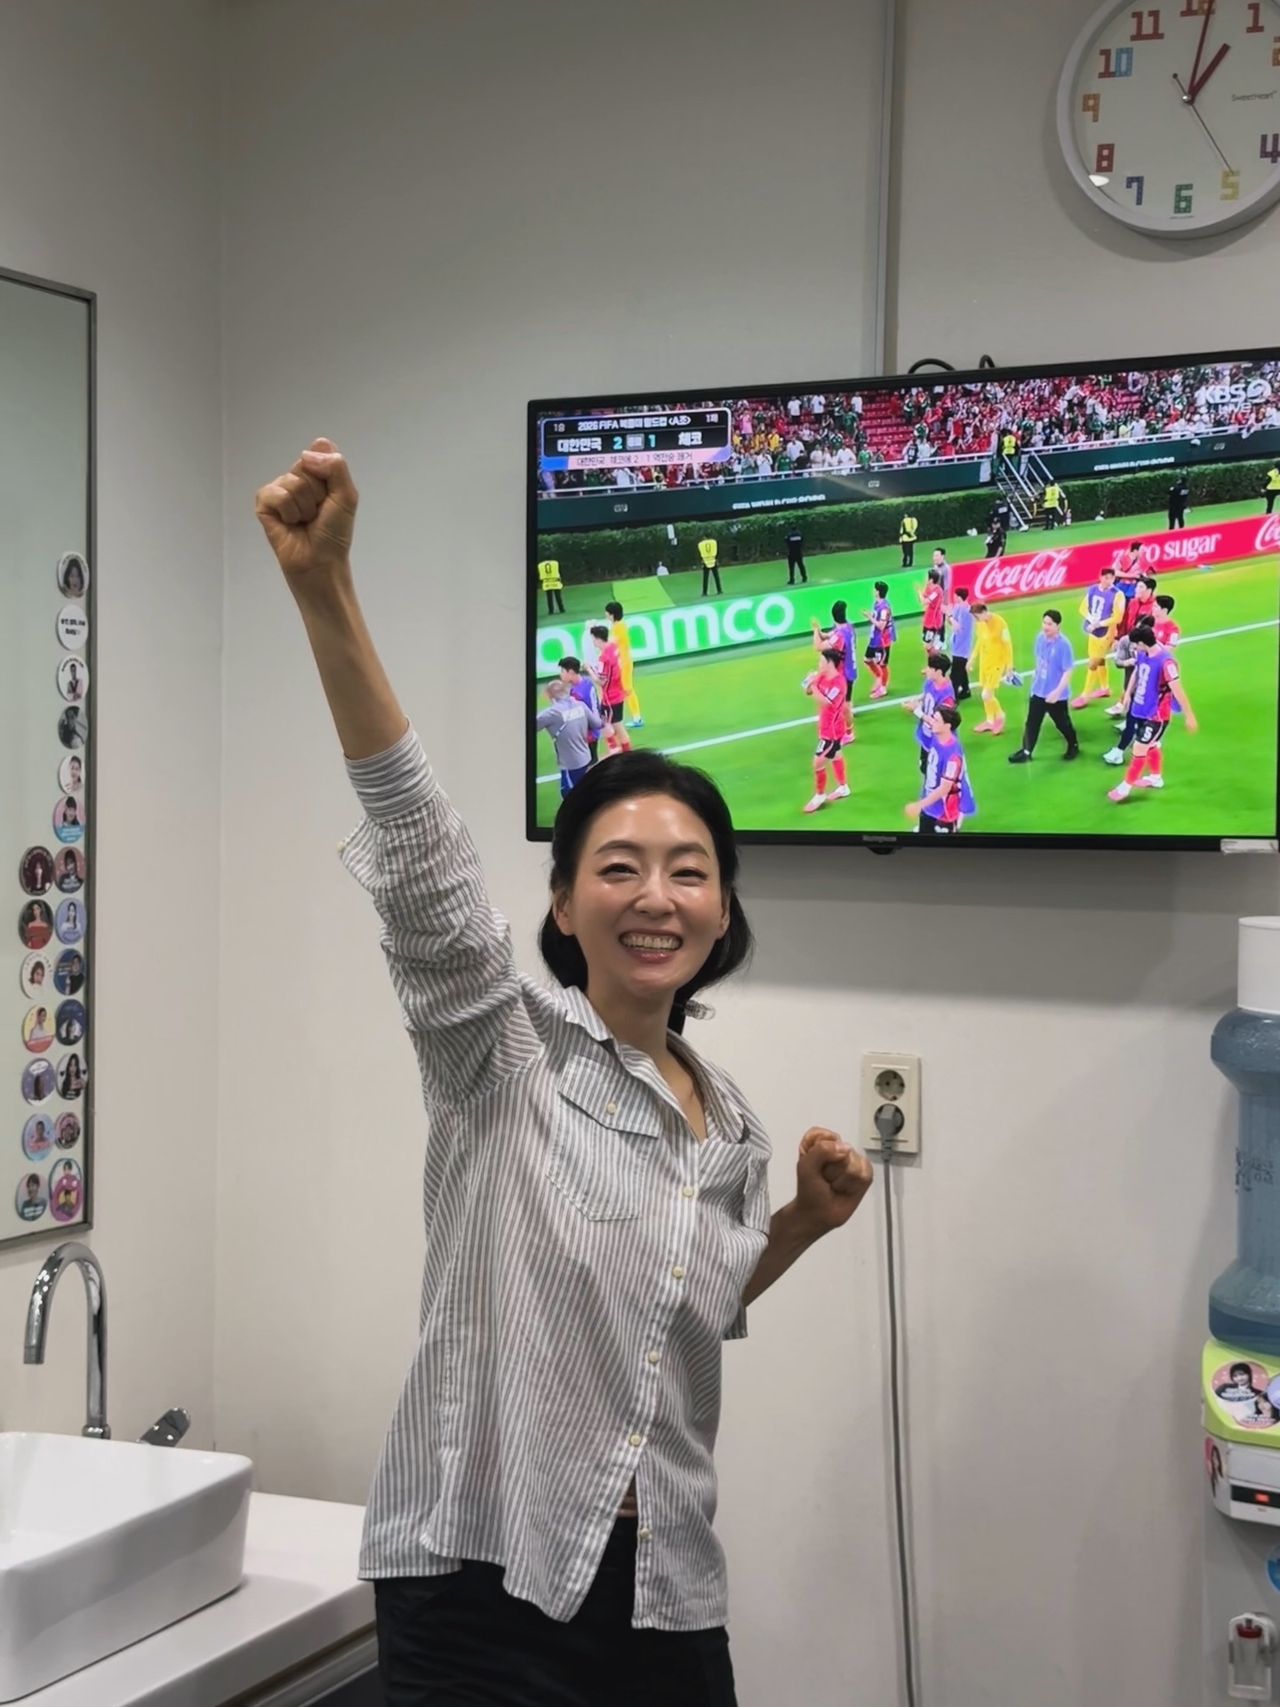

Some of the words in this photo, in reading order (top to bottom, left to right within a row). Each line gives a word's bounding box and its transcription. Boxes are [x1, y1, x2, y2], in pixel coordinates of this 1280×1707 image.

[1130, 10, 1164, 41] 11
[1246, 3, 1264, 33] 1
[1098, 47, 1133, 78] 10
[1082, 93, 1100, 122] 9
[1096, 143, 1115, 172] 8
[1260, 133, 1280, 163] 4
[1126, 176, 1144, 205] 7
[1173, 184, 1193, 214] 6
[1220, 168, 1240, 201] 5
[557, 437, 602, 453] 대한민국
[613, 436, 623, 450] 2
[648, 434, 656, 448] 1
[1163, 534, 1222, 561] sugar
[974, 548, 1073, 600] Coca-Cola
